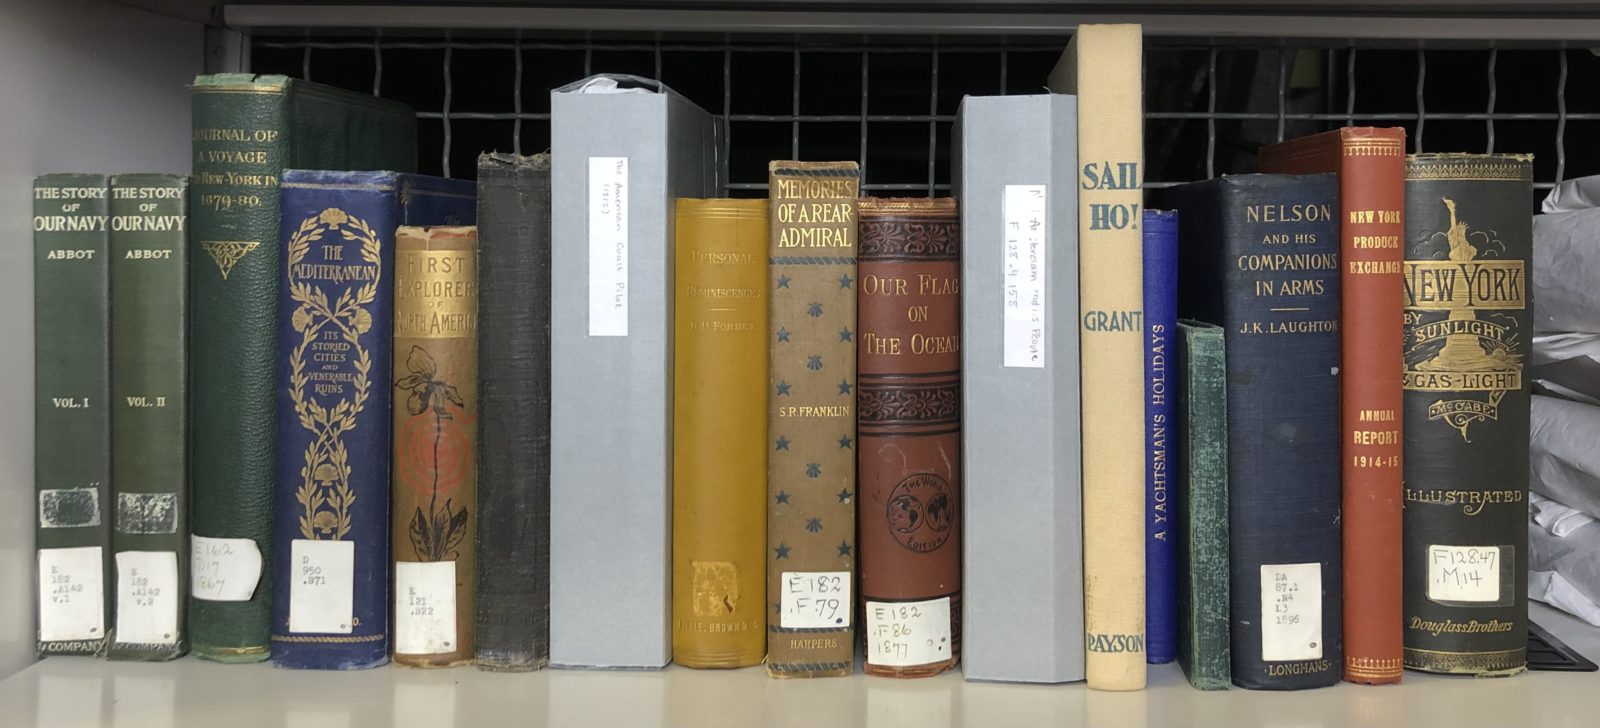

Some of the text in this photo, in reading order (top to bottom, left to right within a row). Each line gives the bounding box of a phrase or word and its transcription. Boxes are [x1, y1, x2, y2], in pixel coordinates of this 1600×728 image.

[254, 130, 278, 142] OF
[208, 150, 267, 164] VOYAGE
[265, 175, 278, 186] IN
[1082, 161, 1142, 190] SAIL
[34, 188, 108, 198] THE STORY
[112, 188, 184, 198] THE STORY
[778, 180, 852, 198] MEMORIES
[62, 204, 80, 212] OF
[140, 204, 158, 212] OF
[778, 204, 854, 222] OF A REAR-
[1247, 204, 1331, 222] NELSON
[34, 216, 108, 231] OUR NAVY
[112, 216, 186, 231] OUR NAVY
[1090, 204, 1138, 230] HO!
[1350, 210, 1400, 224] NEW YORK
[778, 228, 852, 248] ADMIRAL
[1262, 234, 1316, 244] AND HIS
[1353, 236, 1398, 248] PRODUCE
[48, 250, 95, 259] ABBOT
[125, 250, 172, 259] ABBOT
[322, 245, 344, 260] THE
[408, 254, 465, 273] FIRST
[1238, 254, 1336, 271] COMPANIONS
[1350, 261, 1401, 273] EXCHANGE
[293, 264, 376, 284] MEDITERRANEAN
[864, 274, 958, 296] OUR FLAG
[1256, 280, 1324, 296] IN ARMS
[1458, 264, 1522, 307] YORK
[614, 282, 624, 310] Pilot
[908, 306, 928, 322] ON
[1404, 312, 1422, 325] BY
[396, 312, 426, 332] NORTH
[430, 311, 476, 334] AMERIC
[1084, 311, 1142, 332] GRANT
[324, 331, 338, 340] ITS
[1416, 322, 1505, 342] SUNLIGHT
[312, 342, 350, 352] STORIED
[864, 333, 900, 354] THE
[314, 353, 346, 362] CITIES
[308, 372, 354, 383] VENERABLE
[1414, 373, 1516, 388] GAS-LIGHT
[315, 384, 343, 396] RUINS
[53, 398, 90, 408] VOL. I
[127, 397, 166, 407] VOL. II
[1360, 410, 1395, 421] ANNUAL
[1153, 324, 1166, 542] A YACHTSMAN'S HOLIDAYS
[1353, 430, 1398, 444] REPORT
[1354, 456, 1398, 468] 1914-15
[1402, 484, 1522, 515] LLUSTRATED
[302, 556, 309, 564] D
[302, 566, 322, 576] 950
[409, 587, 416, 596] E
[409, 598, 426, 606] 121
[1275, 604, 1288, 612] L3
[790, 639, 838, 649] HARPERS
[1088, 632, 1144, 652] PAYSON
